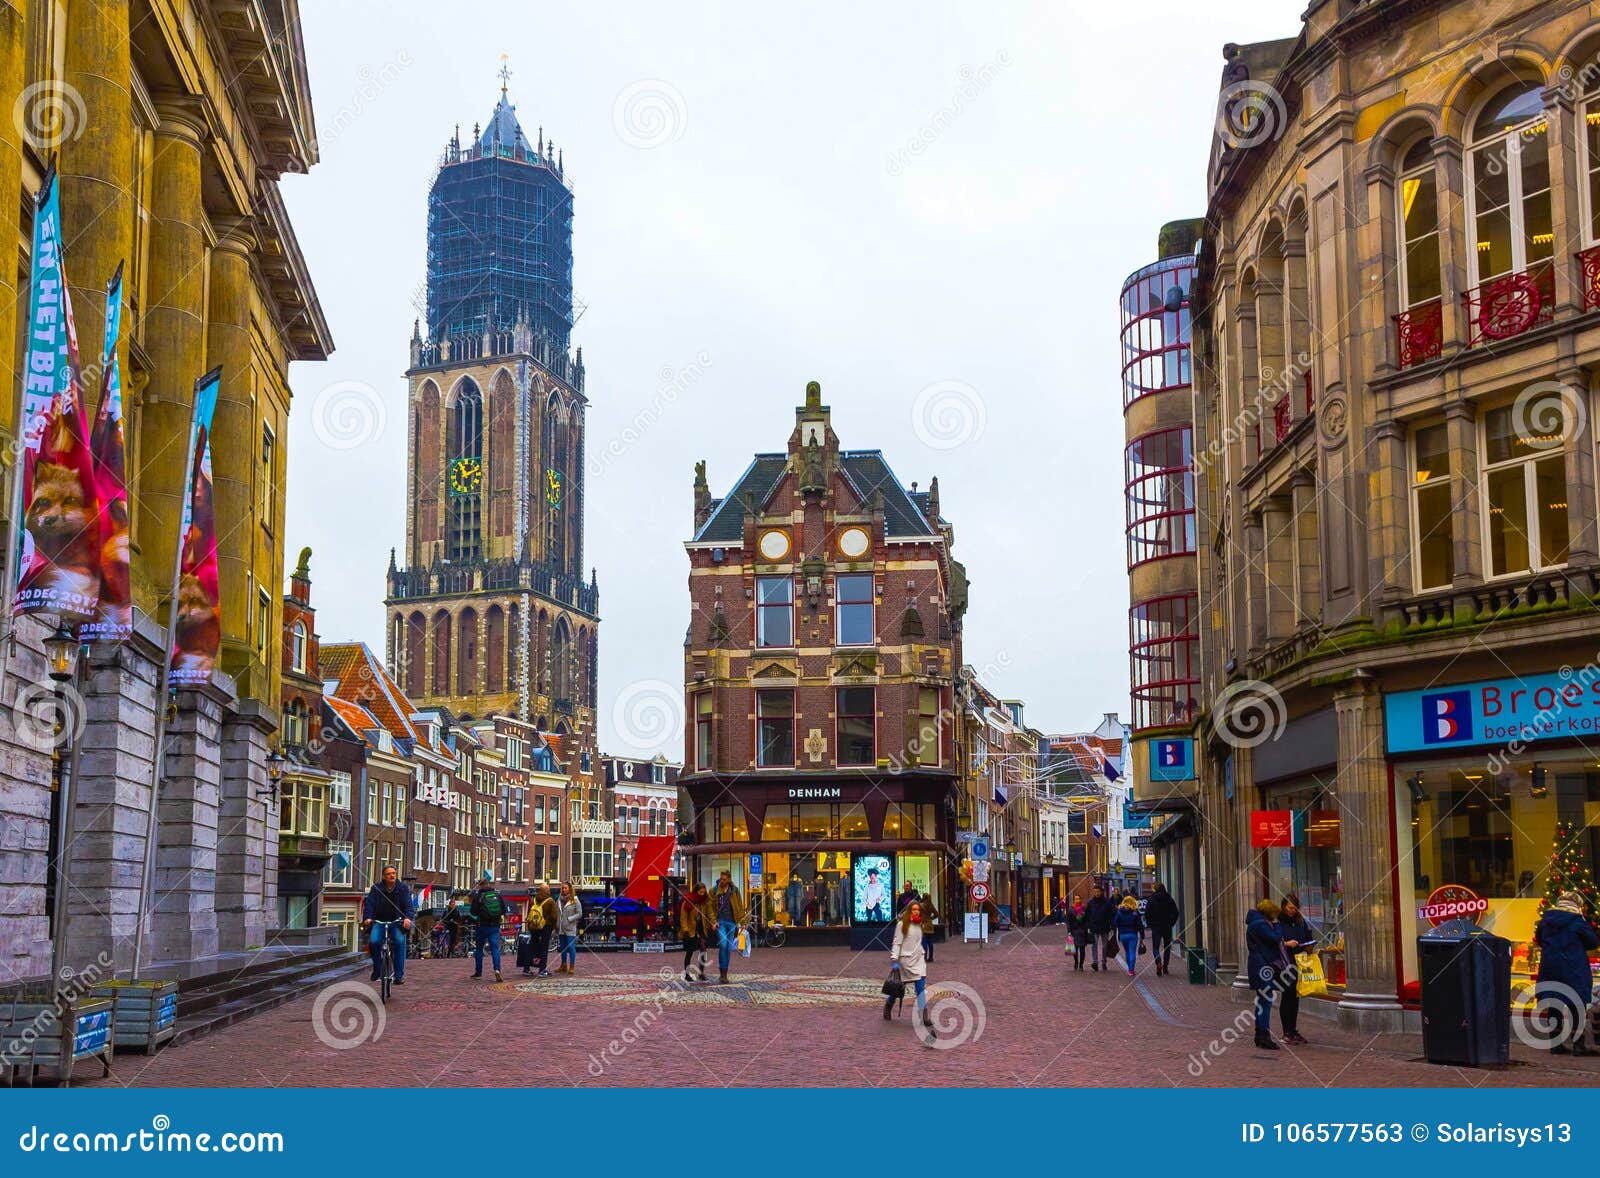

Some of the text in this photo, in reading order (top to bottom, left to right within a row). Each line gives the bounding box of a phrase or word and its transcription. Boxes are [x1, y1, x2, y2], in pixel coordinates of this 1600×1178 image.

[40, 212, 57, 268] EN
[35, 280, 57, 345] HET
[33, 588, 58, 599] DEC
[60, 591, 99, 608] 2017
[89, 623, 108, 632] DEC
[788, 788, 841, 798] DENHAM
[752, 857, 759, 867] P
[1419, 899, 1488, 919] TOP2000
